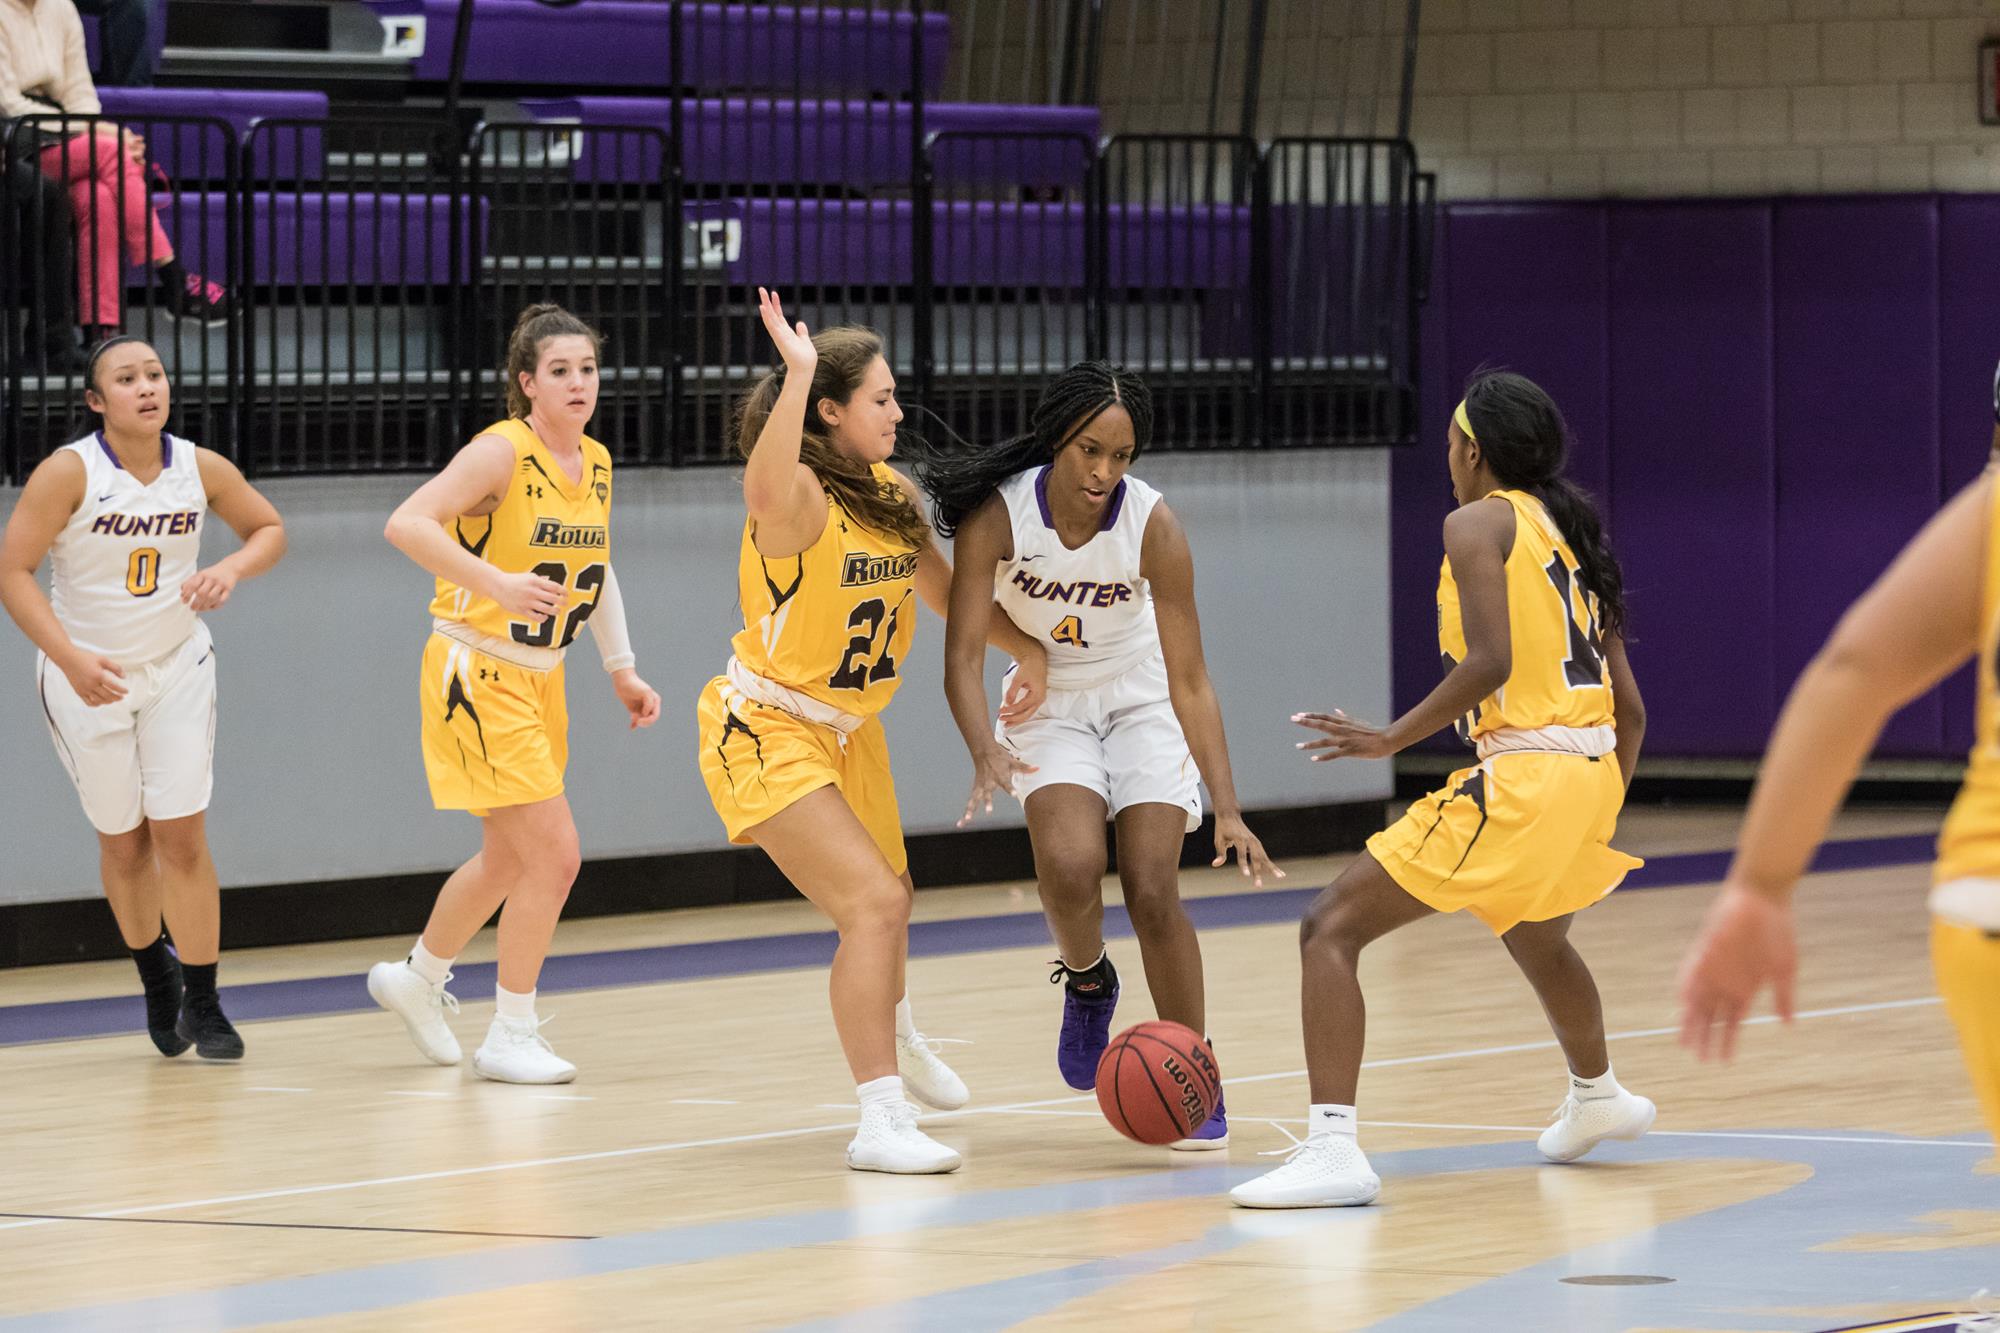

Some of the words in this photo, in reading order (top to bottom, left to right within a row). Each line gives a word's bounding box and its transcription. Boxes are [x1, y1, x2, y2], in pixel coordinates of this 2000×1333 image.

[91, 512, 199, 537] HUNTER
[529, 516, 607, 549] Rowa
[125, 546, 161, 597] 0
[1011, 569, 1133, 608] HUNTER
[828, 588, 914, 693] 21
[1051, 615, 1089, 649] 4
[1163, 1056, 1207, 1133] Wilson
